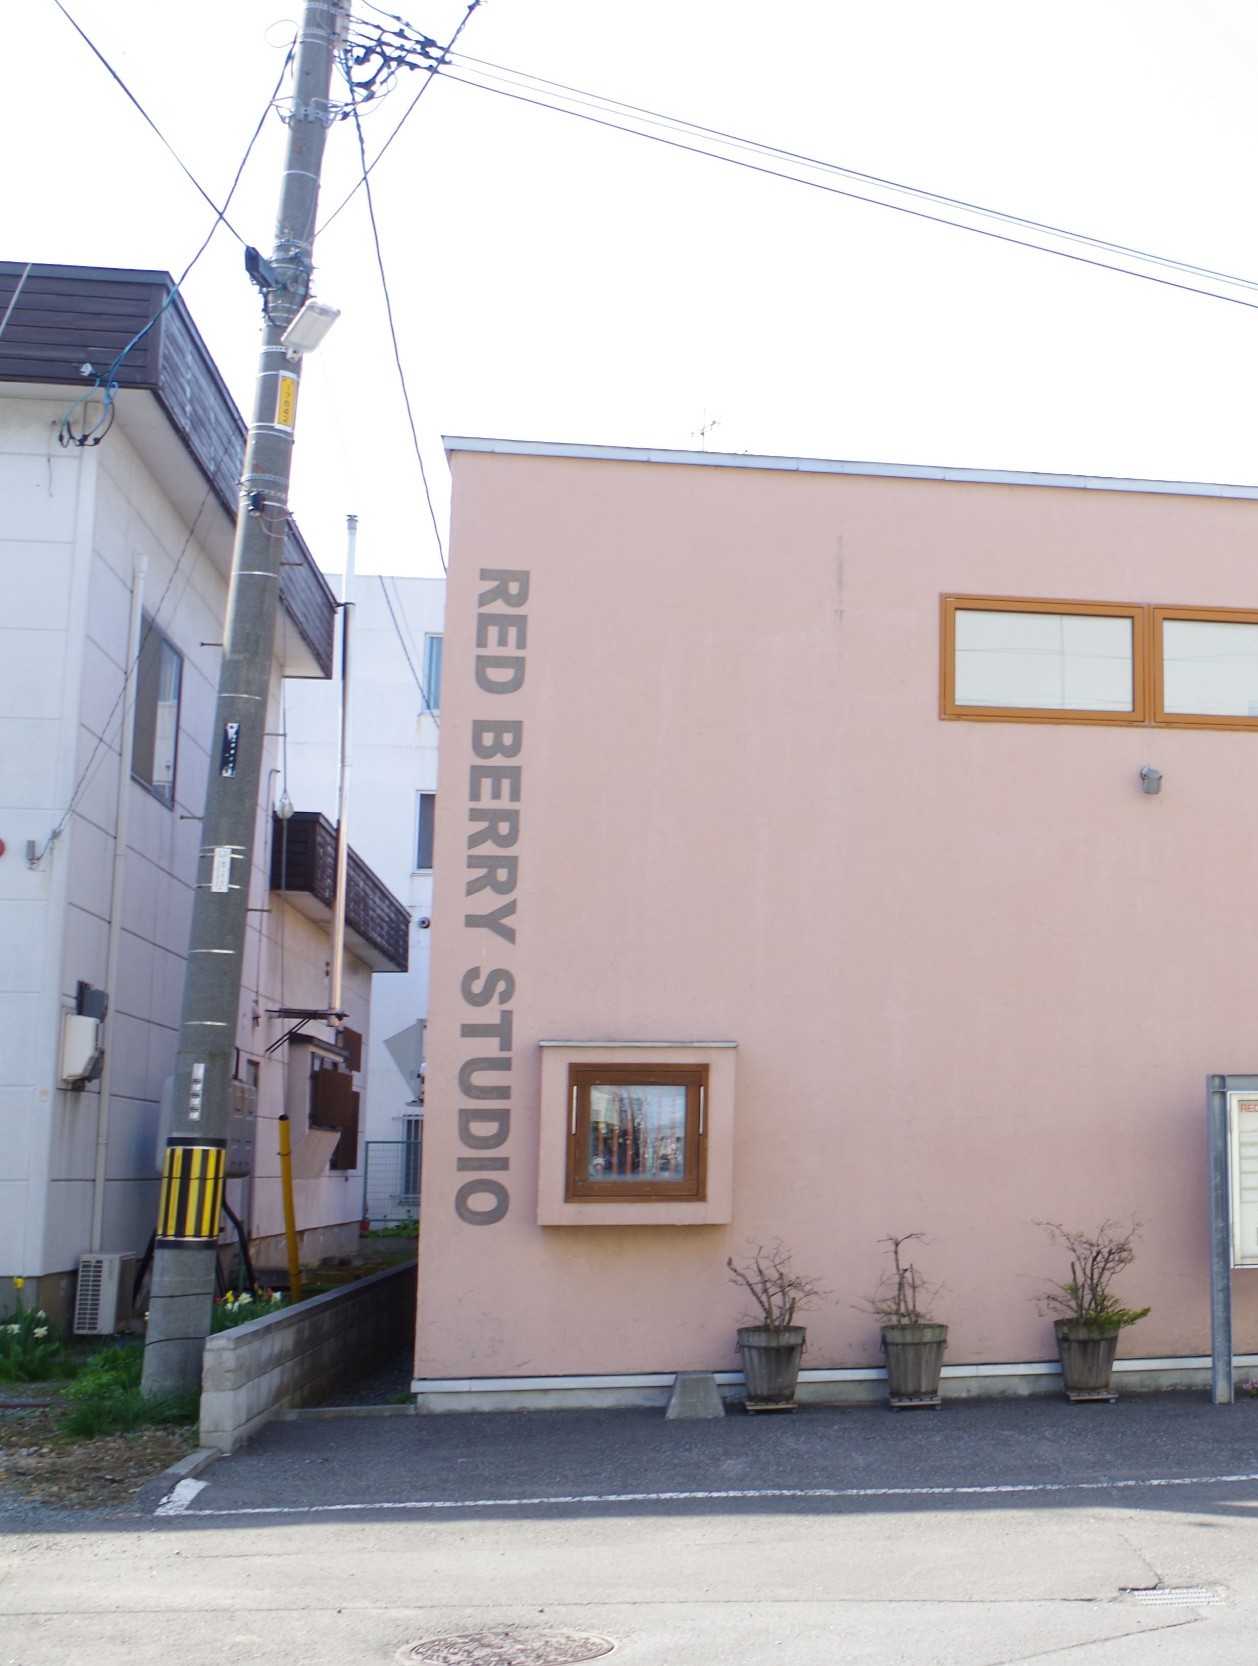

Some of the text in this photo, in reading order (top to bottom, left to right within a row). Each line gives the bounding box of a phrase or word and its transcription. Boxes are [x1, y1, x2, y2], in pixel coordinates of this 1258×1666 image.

[453, 568, 529, 1227] RED BERRY STUDIO
